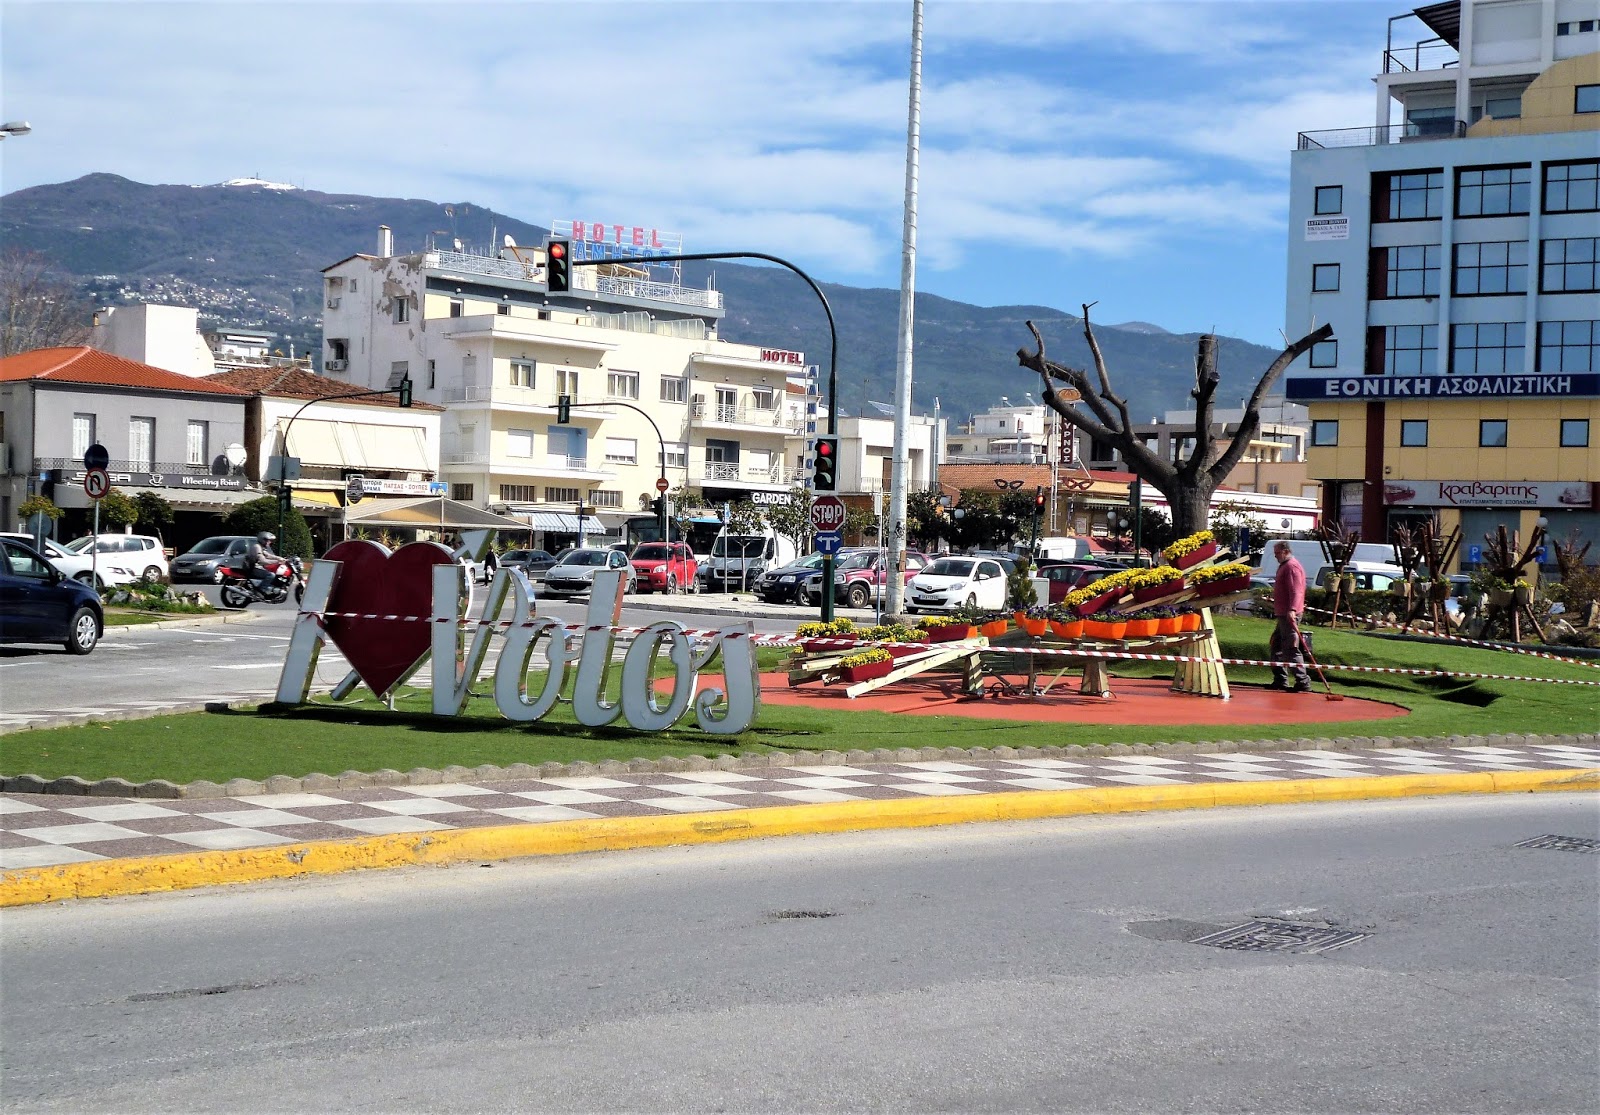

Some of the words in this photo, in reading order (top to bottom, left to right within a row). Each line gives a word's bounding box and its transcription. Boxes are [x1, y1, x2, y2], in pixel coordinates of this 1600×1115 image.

[572, 220, 662, 247] HOTEL
[762, 350, 803, 365] HOTEL
[1436, 376, 1572, 395] ΑΣΦΑΛΙΣΤΙΚΗ
[1063, 418, 1072, 463] ΥΡΝΟΣ
[182, 476, 219, 488] Meeting
[219, 478, 240, 486] Point
[752, 492, 792, 505] GARDEN
[812, 505, 842, 524] STOP
[431, 563, 760, 735] Volos
